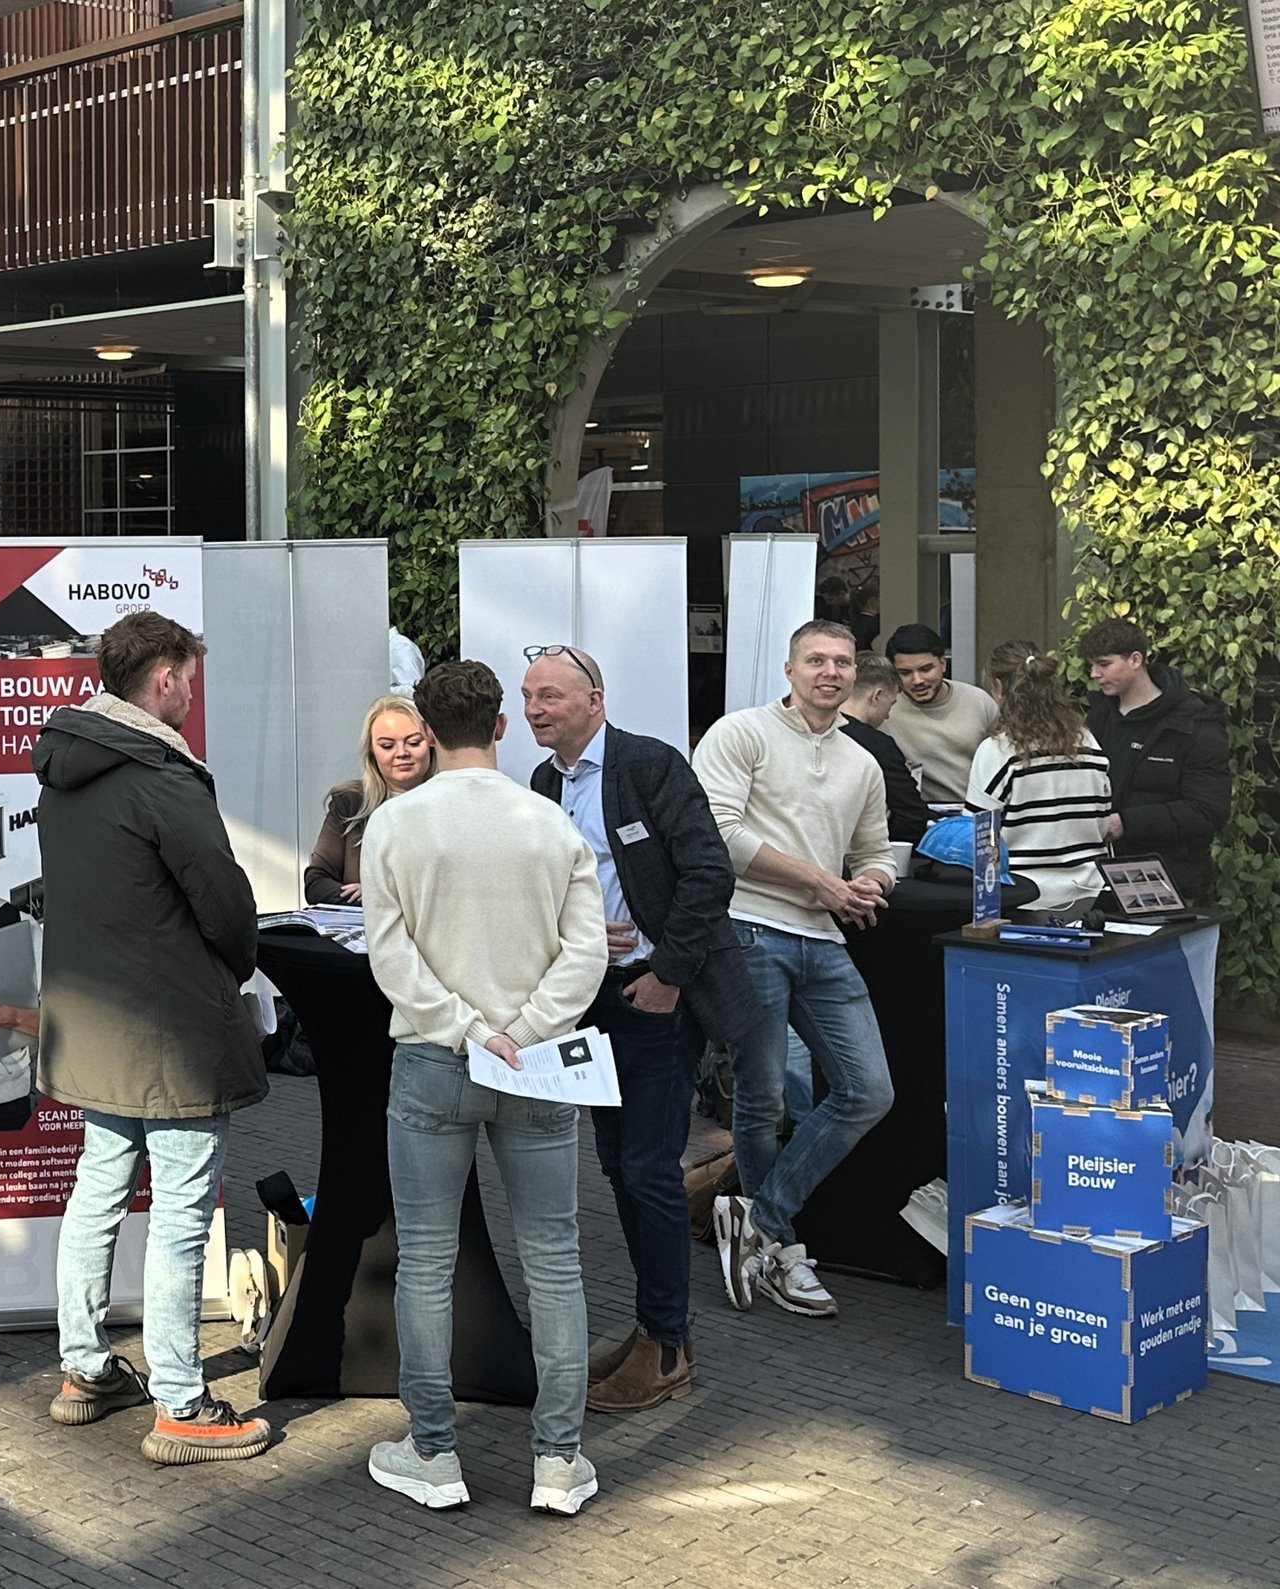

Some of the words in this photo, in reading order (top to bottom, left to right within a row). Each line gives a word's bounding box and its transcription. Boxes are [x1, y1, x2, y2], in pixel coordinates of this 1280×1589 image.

[69, 583, 151, 600] HABOVO
[0, 676, 73, 698] BOUW
[0, 705, 66, 727] TOEK
[997, 983, 1011, 1034] Samen
[997, 1038, 1011, 1090] anders
[1073, 1049, 1102, 1062] Mooie
[1055, 1060, 1120, 1076] vooruitzichten
[38, 1110, 68, 1122] SCAN
[71, 1109, 85, 1120] DE
[38, 1122, 62, 1131] VOOR
[63, 1121, 85, 1130] MEER
[997, 1096, 1011, 1156] bouwen
[0, 1148, 7, 1156] in
[24, 1144, 77, 1155] familiebedrijf
[5, 1159, 40, 1167] moderne
[41, 1157, 76, 1166] software
[1068, 1154, 1136, 1175] Pleijsier
[9, 1170, 38, 1180] collega
[998, 1161, 1008, 1188] aan
[1068, 1172, 1116, 1190] Bouw
[6, 1182, 27, 1191] leuke
[28, 1182, 48, 1190] baan
[60, 1181, 68, 1190] je
[17, 1193, 60, 1204] vergoeding
[995, 1190, 1008, 1205] jo
[984, 1285, 1030, 1309] Geen
[1035, 1301, 1108, 1328] grenzen
[1140, 1307, 1166, 1328] Werk
[1166, 1301, 1183, 1322] met
[1185, 1295, 1201, 1315] een
[994, 1313, 1025, 1330] aan
[1028, 1318, 1045, 1337] je
[1050, 1327, 1097, 1349] groei
[1139, 1329, 1173, 1356] gouden
[1175, 1316, 1202, 1342] randje
